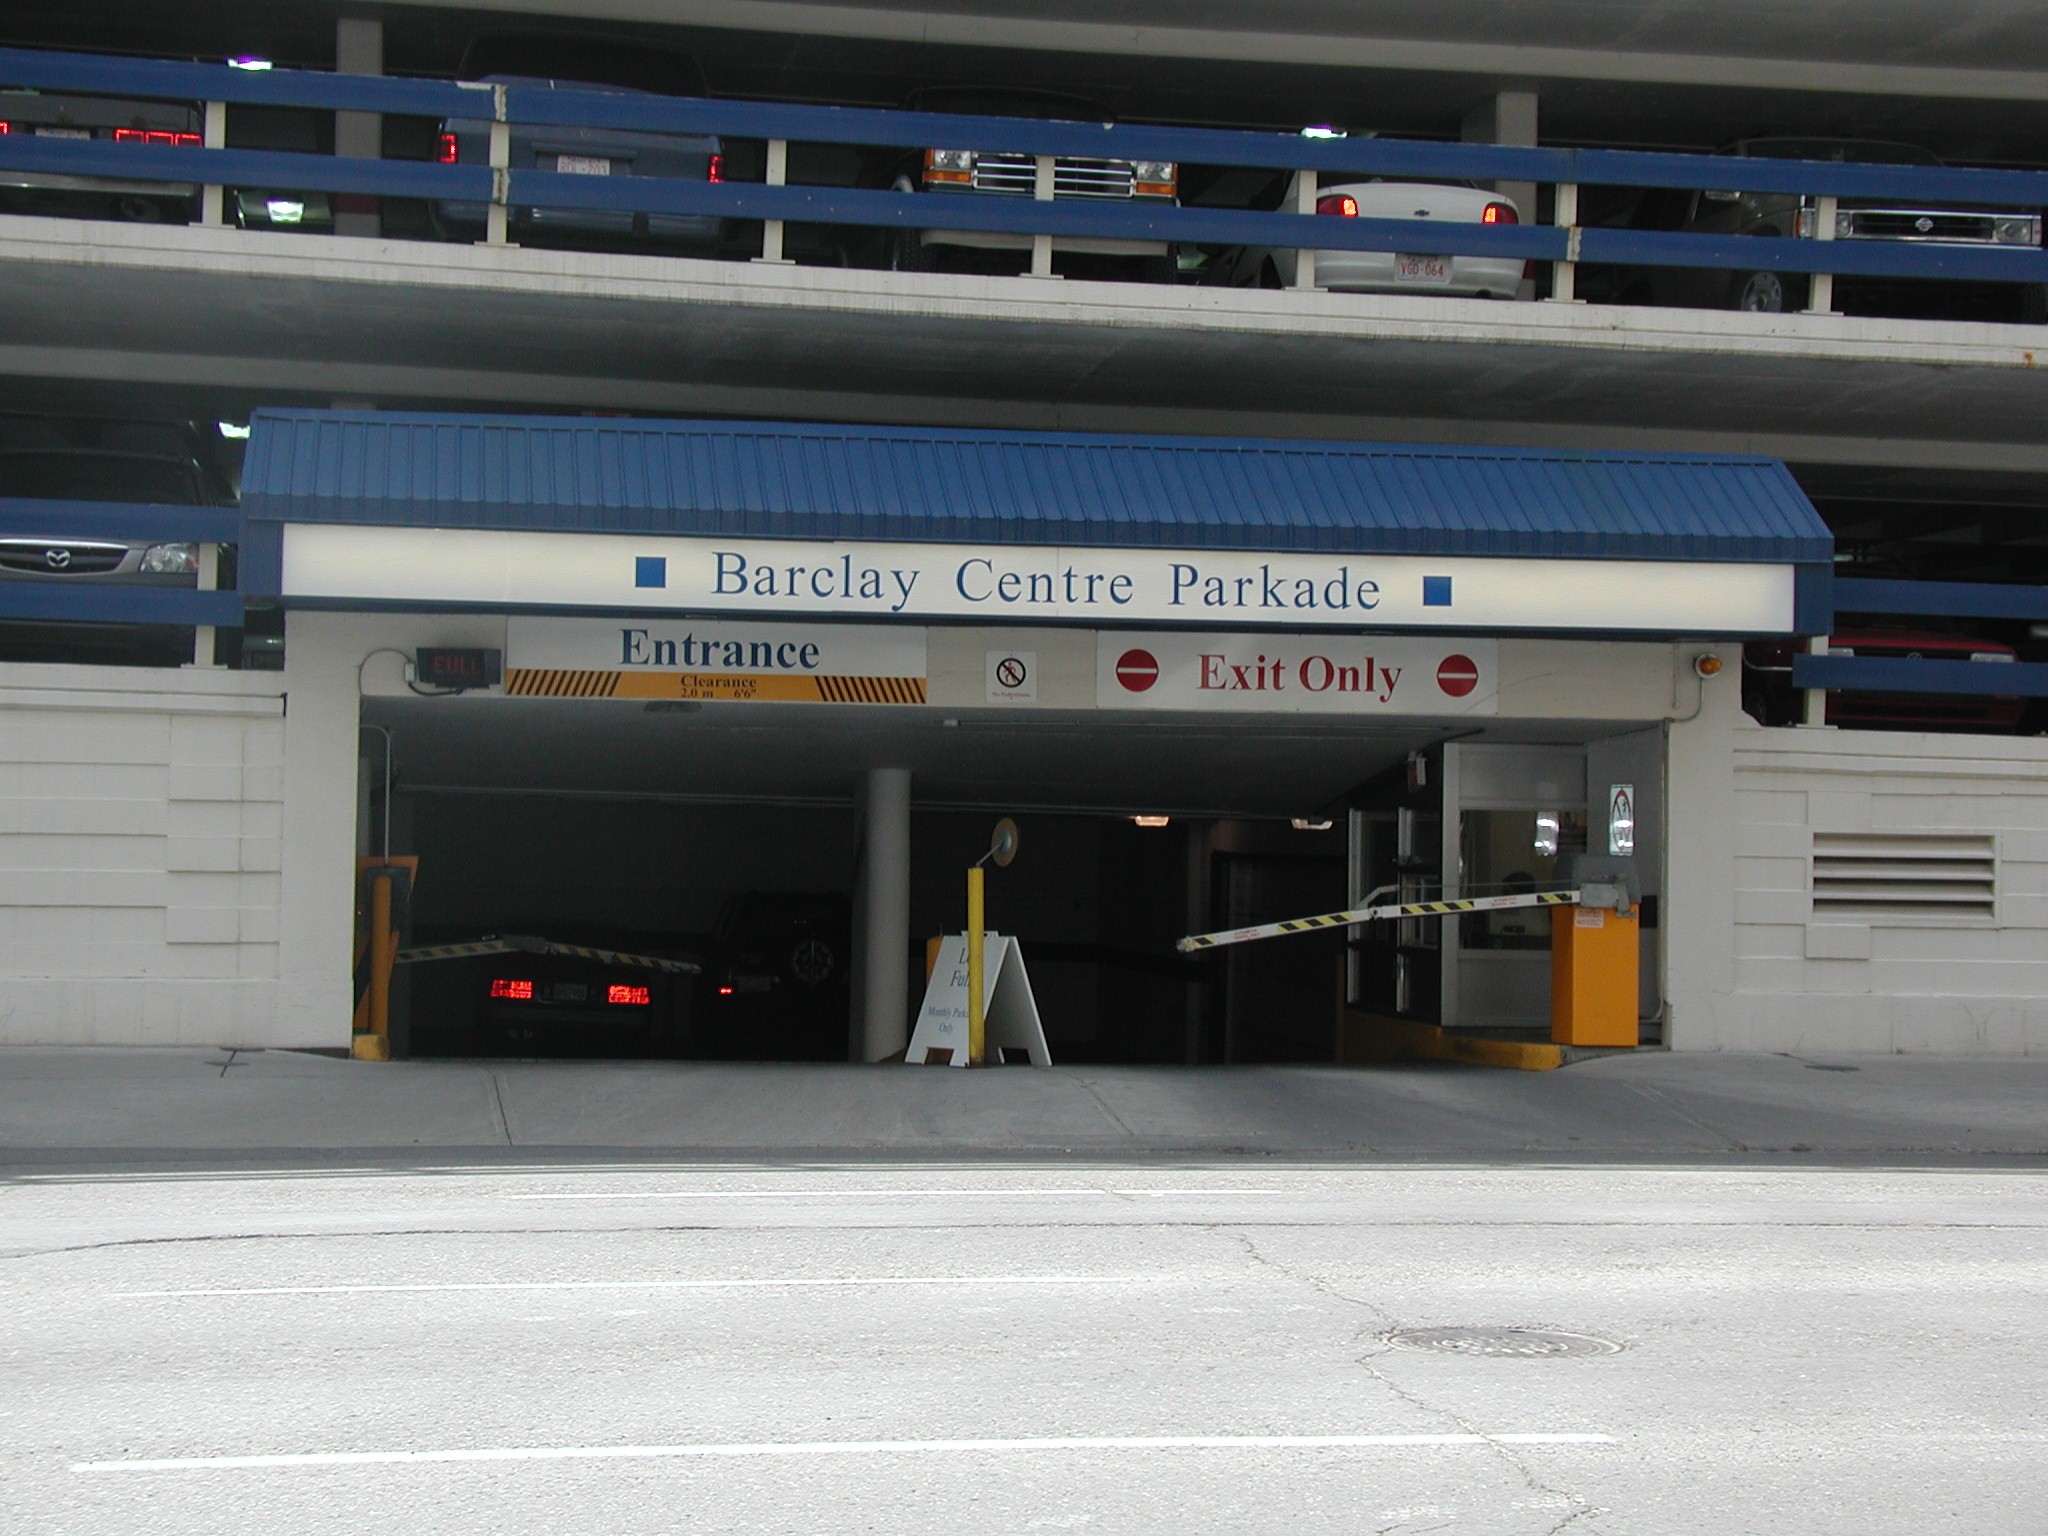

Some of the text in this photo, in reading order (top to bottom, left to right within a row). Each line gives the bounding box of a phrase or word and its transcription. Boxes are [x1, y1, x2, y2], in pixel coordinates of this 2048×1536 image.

[711, 552, 1381, 612] Barclay Centre Parkade
[618, 628, 820, 669] Entrance
[681, 674, 757, 688] Clearance
[681, 687, 698, 698] 2.0
[702, 690, 713, 698] m
[1198, 654, 1402, 703] Exit Only
